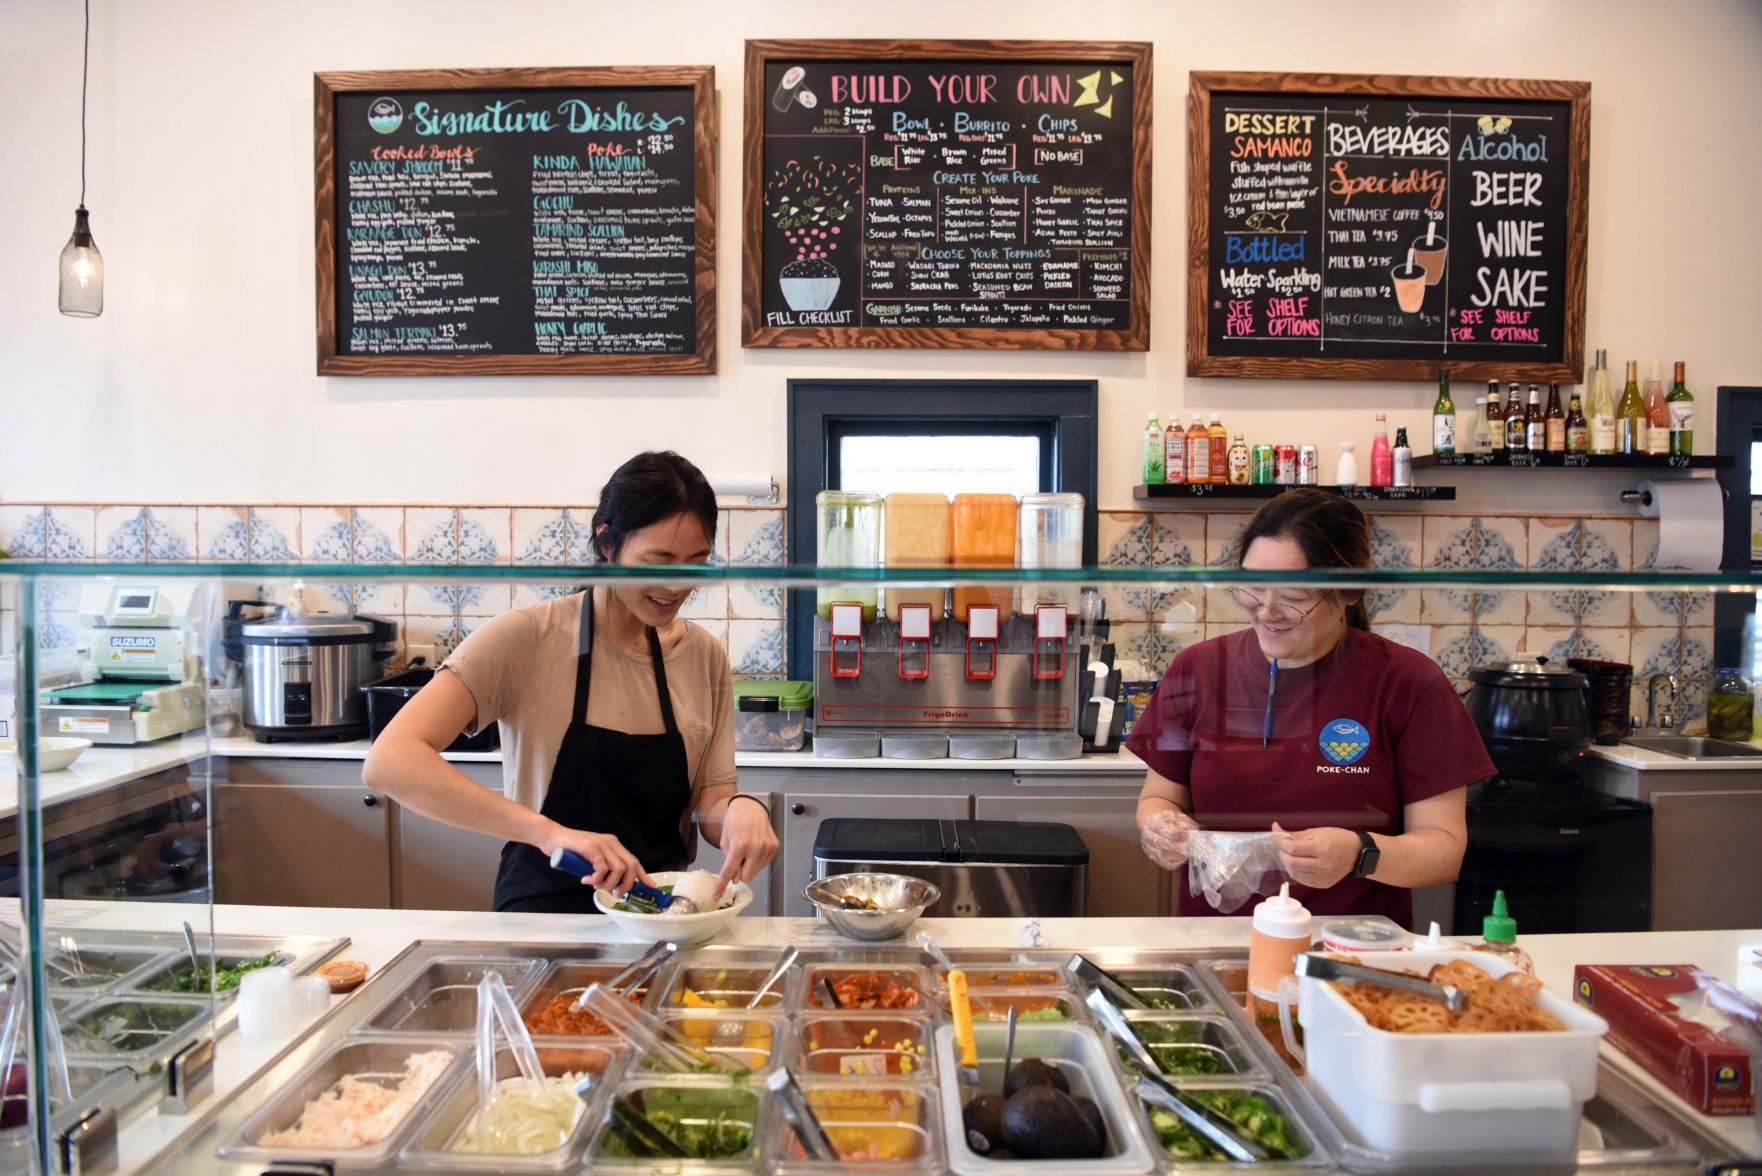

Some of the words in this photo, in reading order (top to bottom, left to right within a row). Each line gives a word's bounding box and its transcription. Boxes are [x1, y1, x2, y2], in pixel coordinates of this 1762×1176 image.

[831, 75, 912, 104] BUILD
[928, 74, 998, 104] YOUR
[1016, 74, 1071, 104] OWN
[408, 99, 560, 136] Signature
[557, 99, 685, 134] Dishes
[954, 112, 1011, 133] BURRITO
[1038, 113, 1078, 133] CHIPS
[1225, 112, 1316, 135] DESSERT
[1230, 135, 1313, 158] SAMANCO
[1327, 122, 1450, 157] BEVERAGES
[370, 144, 426, 160] Cooked
[429, 144, 482, 160] Bowls
[587, 142, 632, 157] Poke
[902, 147, 926, 156] White
[941, 147, 967, 156] Brown
[1457, 134, 1549, 162] Alcohol
[533, 155, 580, 169] KINDA
[870, 155, 895, 167] BASE
[904, 155, 921, 165] Rice
[946, 156, 963, 165] Rice
[980, 156, 1007, 165] Greens
[1057, 151, 1080, 162] BASE
[349, 160, 396, 175] SAVORY
[1230, 160, 1251, 174] Fish
[933, 170, 976, 185] CREATE
[982, 171, 1009, 184] YOUR
[1013, 170, 1040, 184] POKE
[1053, 185, 1104, 196] MARINADE
[1329, 160, 1447, 210] Specialty
[1470, 170, 1543, 207] BEER
[349, 199, 396, 213] CHASHU
[869, 198, 893, 207] TUNA
[903, 197, 931, 207] SALMON
[1328, 208, 1392, 222] VIETNAMESE
[1393, 208, 1421, 220] COFFEE
[402, 226, 423, 238] DON
[1327, 229, 1350, 243] THAI
[1351, 229, 1367, 243] TEA
[1476, 220, 1545, 258] WINE
[921, 247, 966, 260] CHOOSE
[970, 247, 998, 260] YOUR
[1002, 247, 1052, 260] TOPPINGS
[1226, 234, 1305, 264] Bottled
[1328, 255, 1350, 269] MILK
[1351, 255, 1366, 269] TEA
[1220, 267, 1265, 289] Water
[1266, 266, 1322, 292] Sparkling
[532, 286, 557, 297] THAI
[565, 286, 592, 297] SPICE
[1364, 286, 1377, 298] TEA
[1379, 286, 1391, 298] $2
[1470, 266, 1549, 307] SAKE
[1226, 299, 1254, 319] SEE
[1266, 296, 1310, 318] SHELF
[766, 311, 795, 327] FILL
[799, 310, 853, 325] CHECKLIST
[1460, 309, 1484, 324] SEE
[1495, 308, 1532, 324] SHELF
[534, 321, 566, 335] HONEY
[1226, 317, 1256, 337] FOR
[1268, 317, 1321, 337] OPTIONS
[1451, 327, 1476, 342] FOR
[1490, 326, 1540, 342] OPTIONS
[111, 637, 155, 648] SUZUMO
[923, 710, 969, 719] FrigoDrink
[1316, 765, 1370, 774] POKE-CHAN
